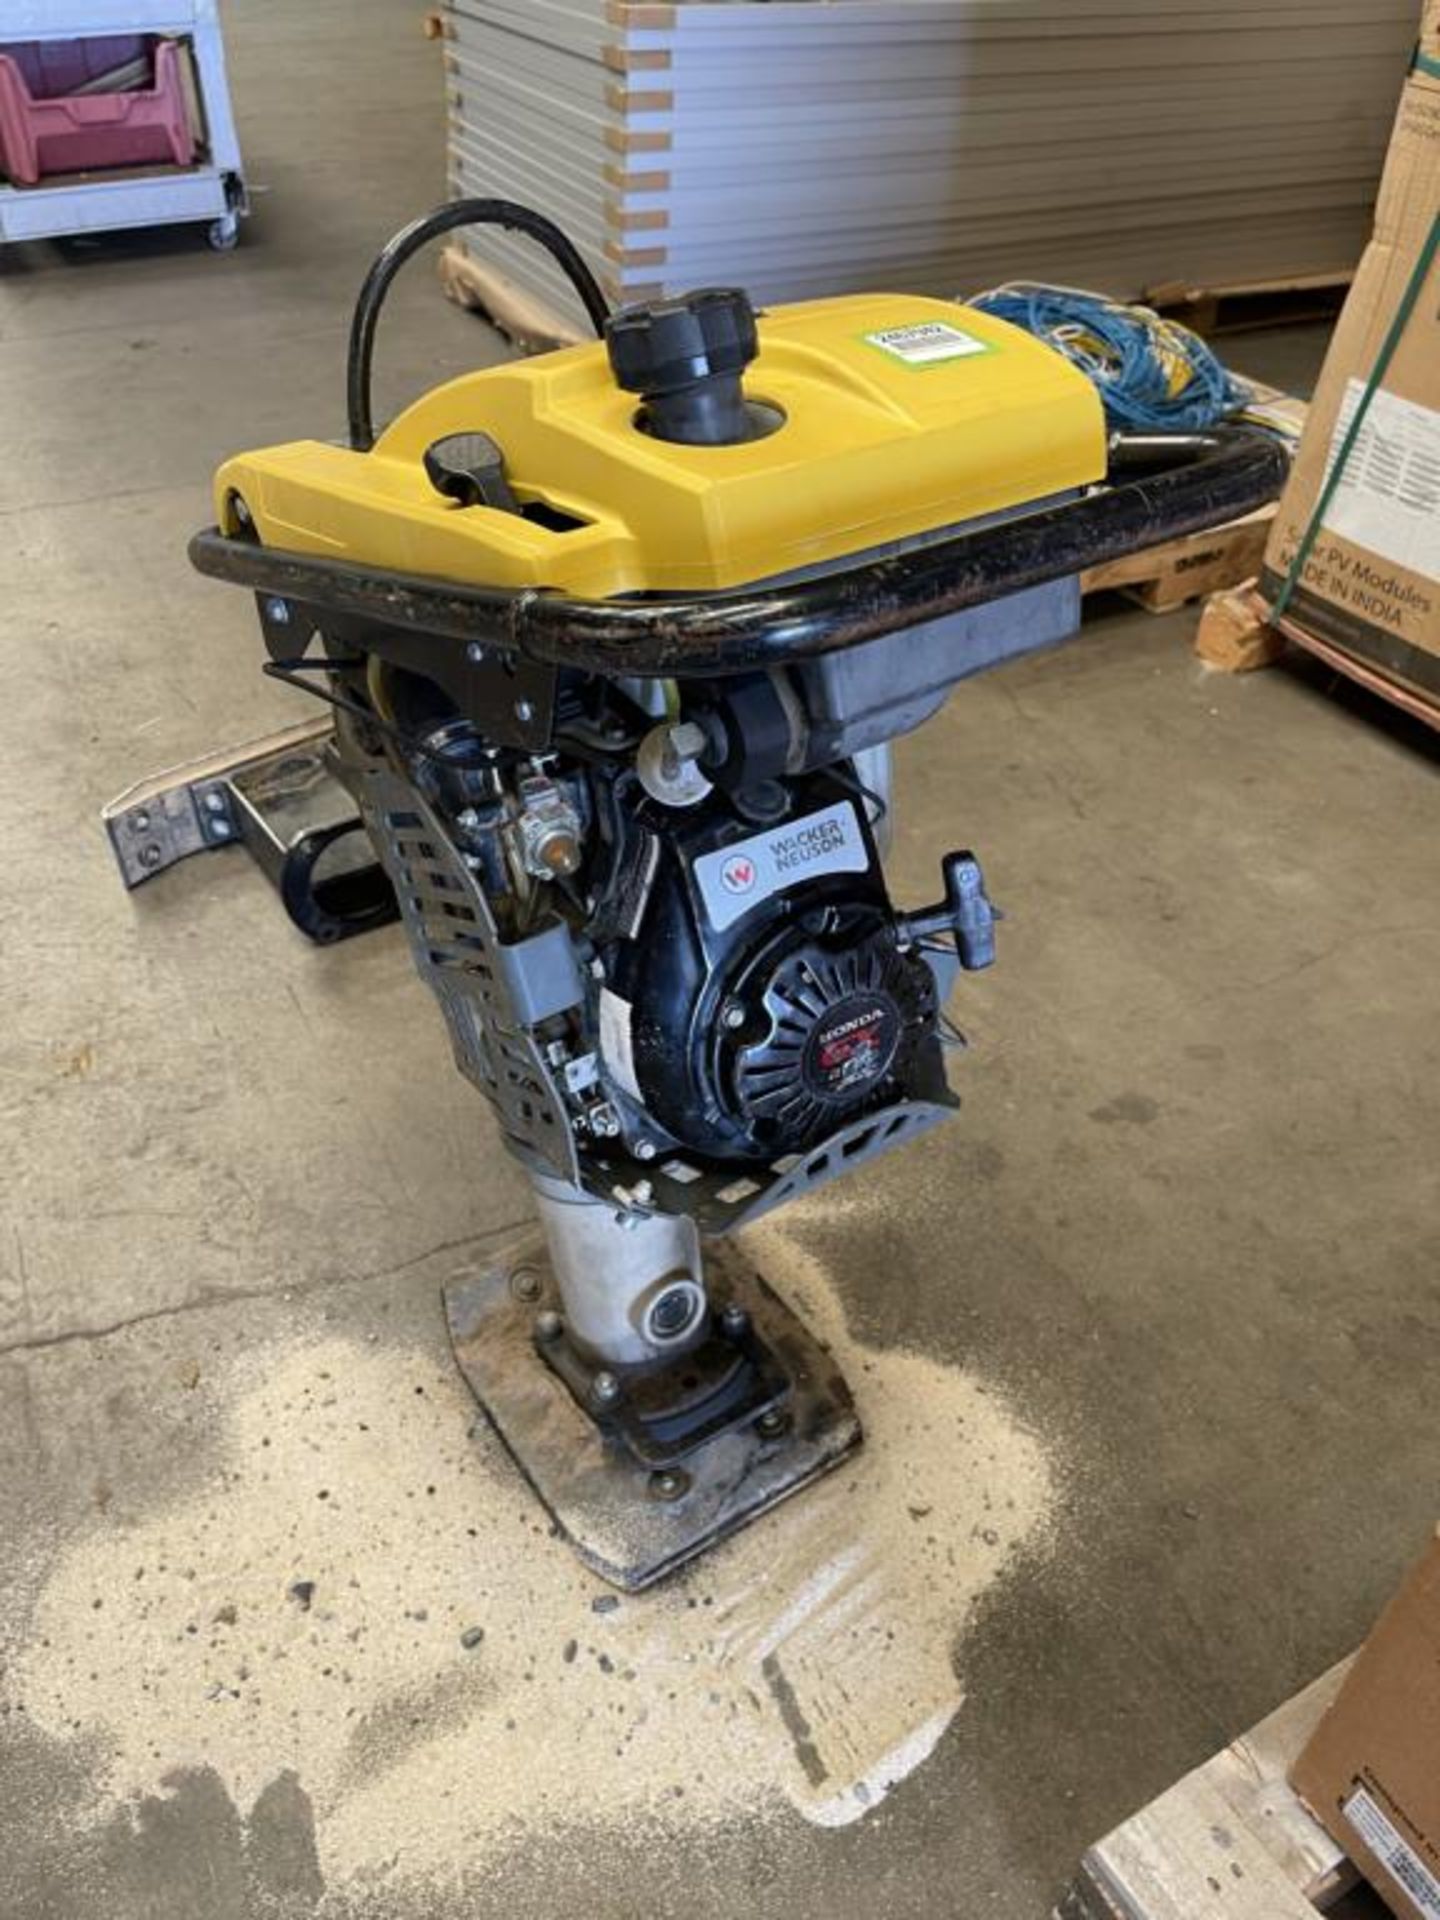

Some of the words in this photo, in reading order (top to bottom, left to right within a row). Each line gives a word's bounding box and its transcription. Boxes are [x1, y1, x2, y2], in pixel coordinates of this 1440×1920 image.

[1281, 549, 1328, 588] MDE
[1329, 576, 1349, 600] IN
[1352, 588, 1401, 626] INDIA
[1327, 546, 1351, 571] PV
[1352, 561, 1431, 613] Modules
[769, 819, 841, 856] WACKER
[775, 834, 846, 872] NEUSON
[819, 1009, 885, 1044] HONDA
